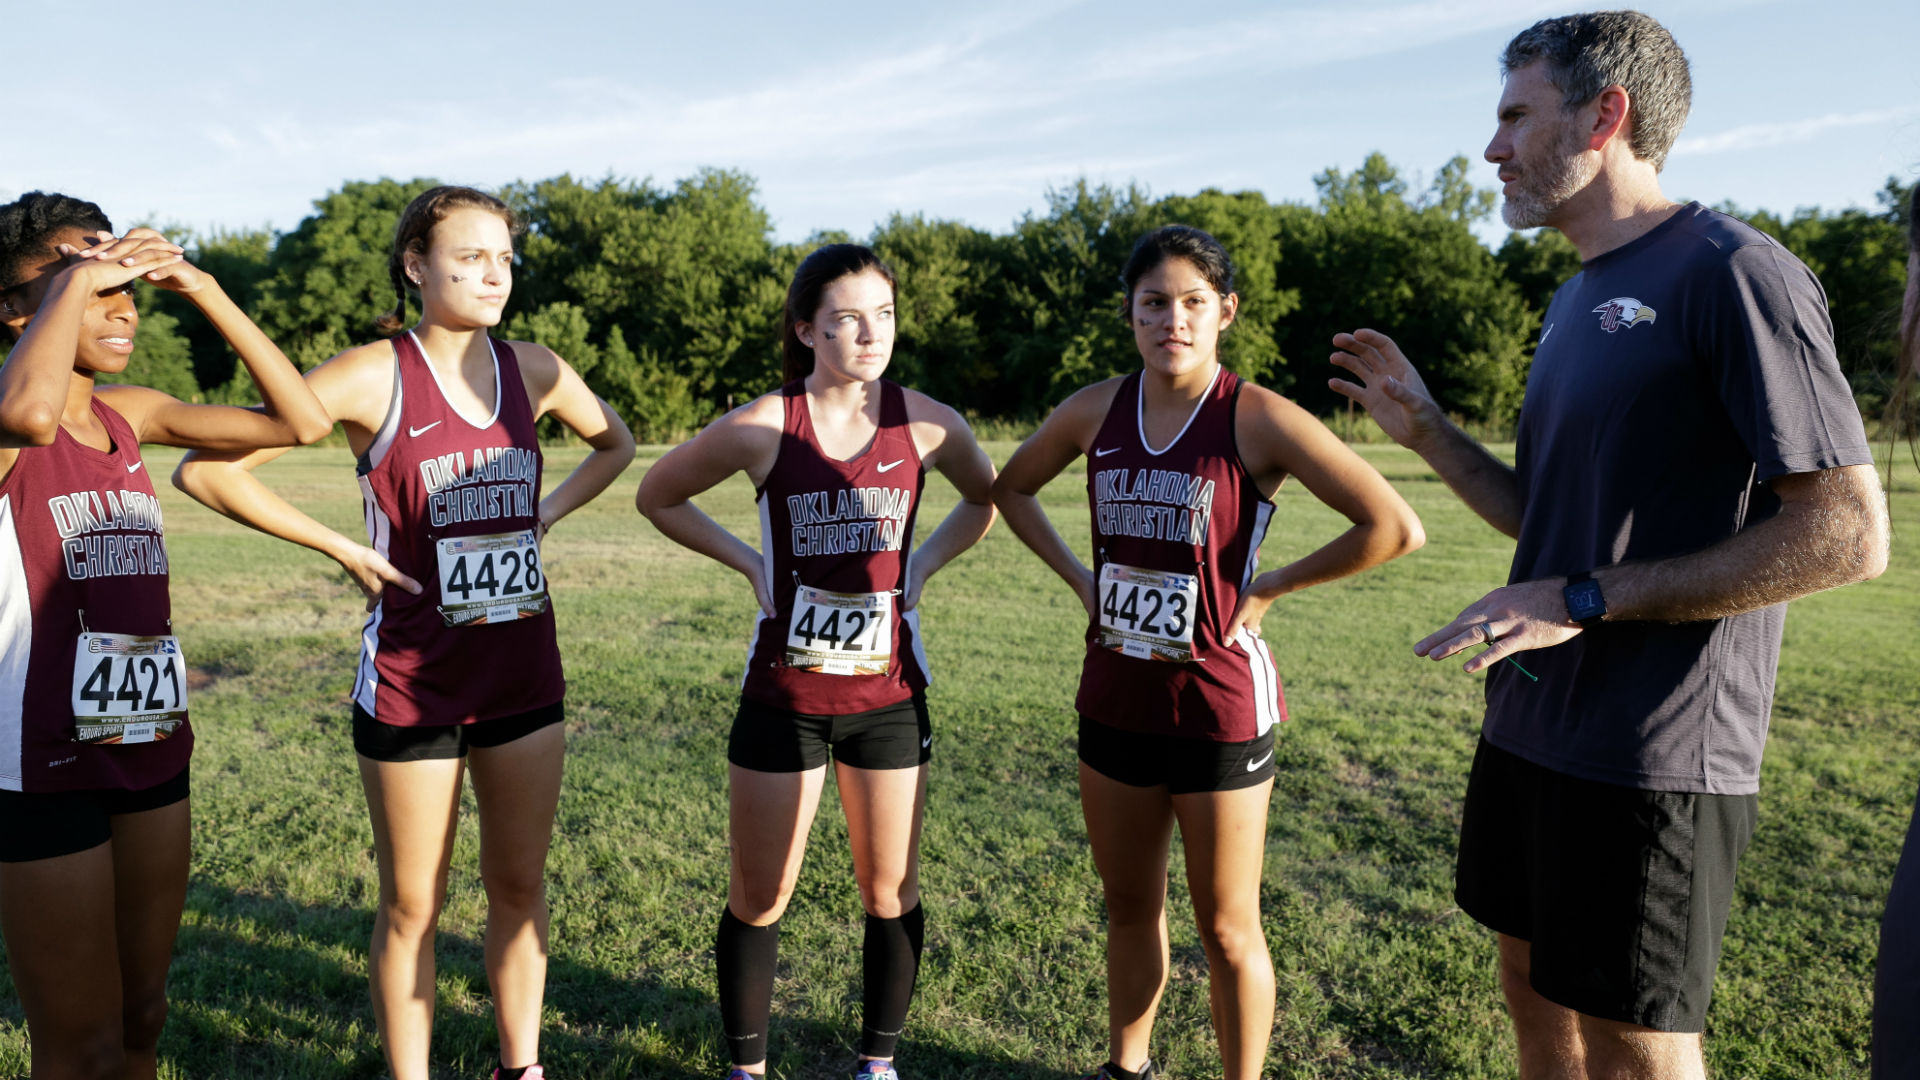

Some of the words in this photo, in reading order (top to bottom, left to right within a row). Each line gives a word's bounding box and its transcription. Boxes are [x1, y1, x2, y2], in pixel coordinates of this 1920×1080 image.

[420, 447, 537, 494] OKLAHOMA
[1095, 468, 1215, 514] OKLAHOMA
[48, 489, 164, 539] OKLAHOM
[787, 487, 910, 526] OKLAHOMA
[1096, 503, 1211, 547] CHRISTIAN
[792, 520, 906, 556] CHRISTIAN
[447, 548, 539, 600] 4428
[794, 605, 886, 651] 4427
[1103, 582, 1187, 638] 4423
[80, 656, 180, 712] 4421
